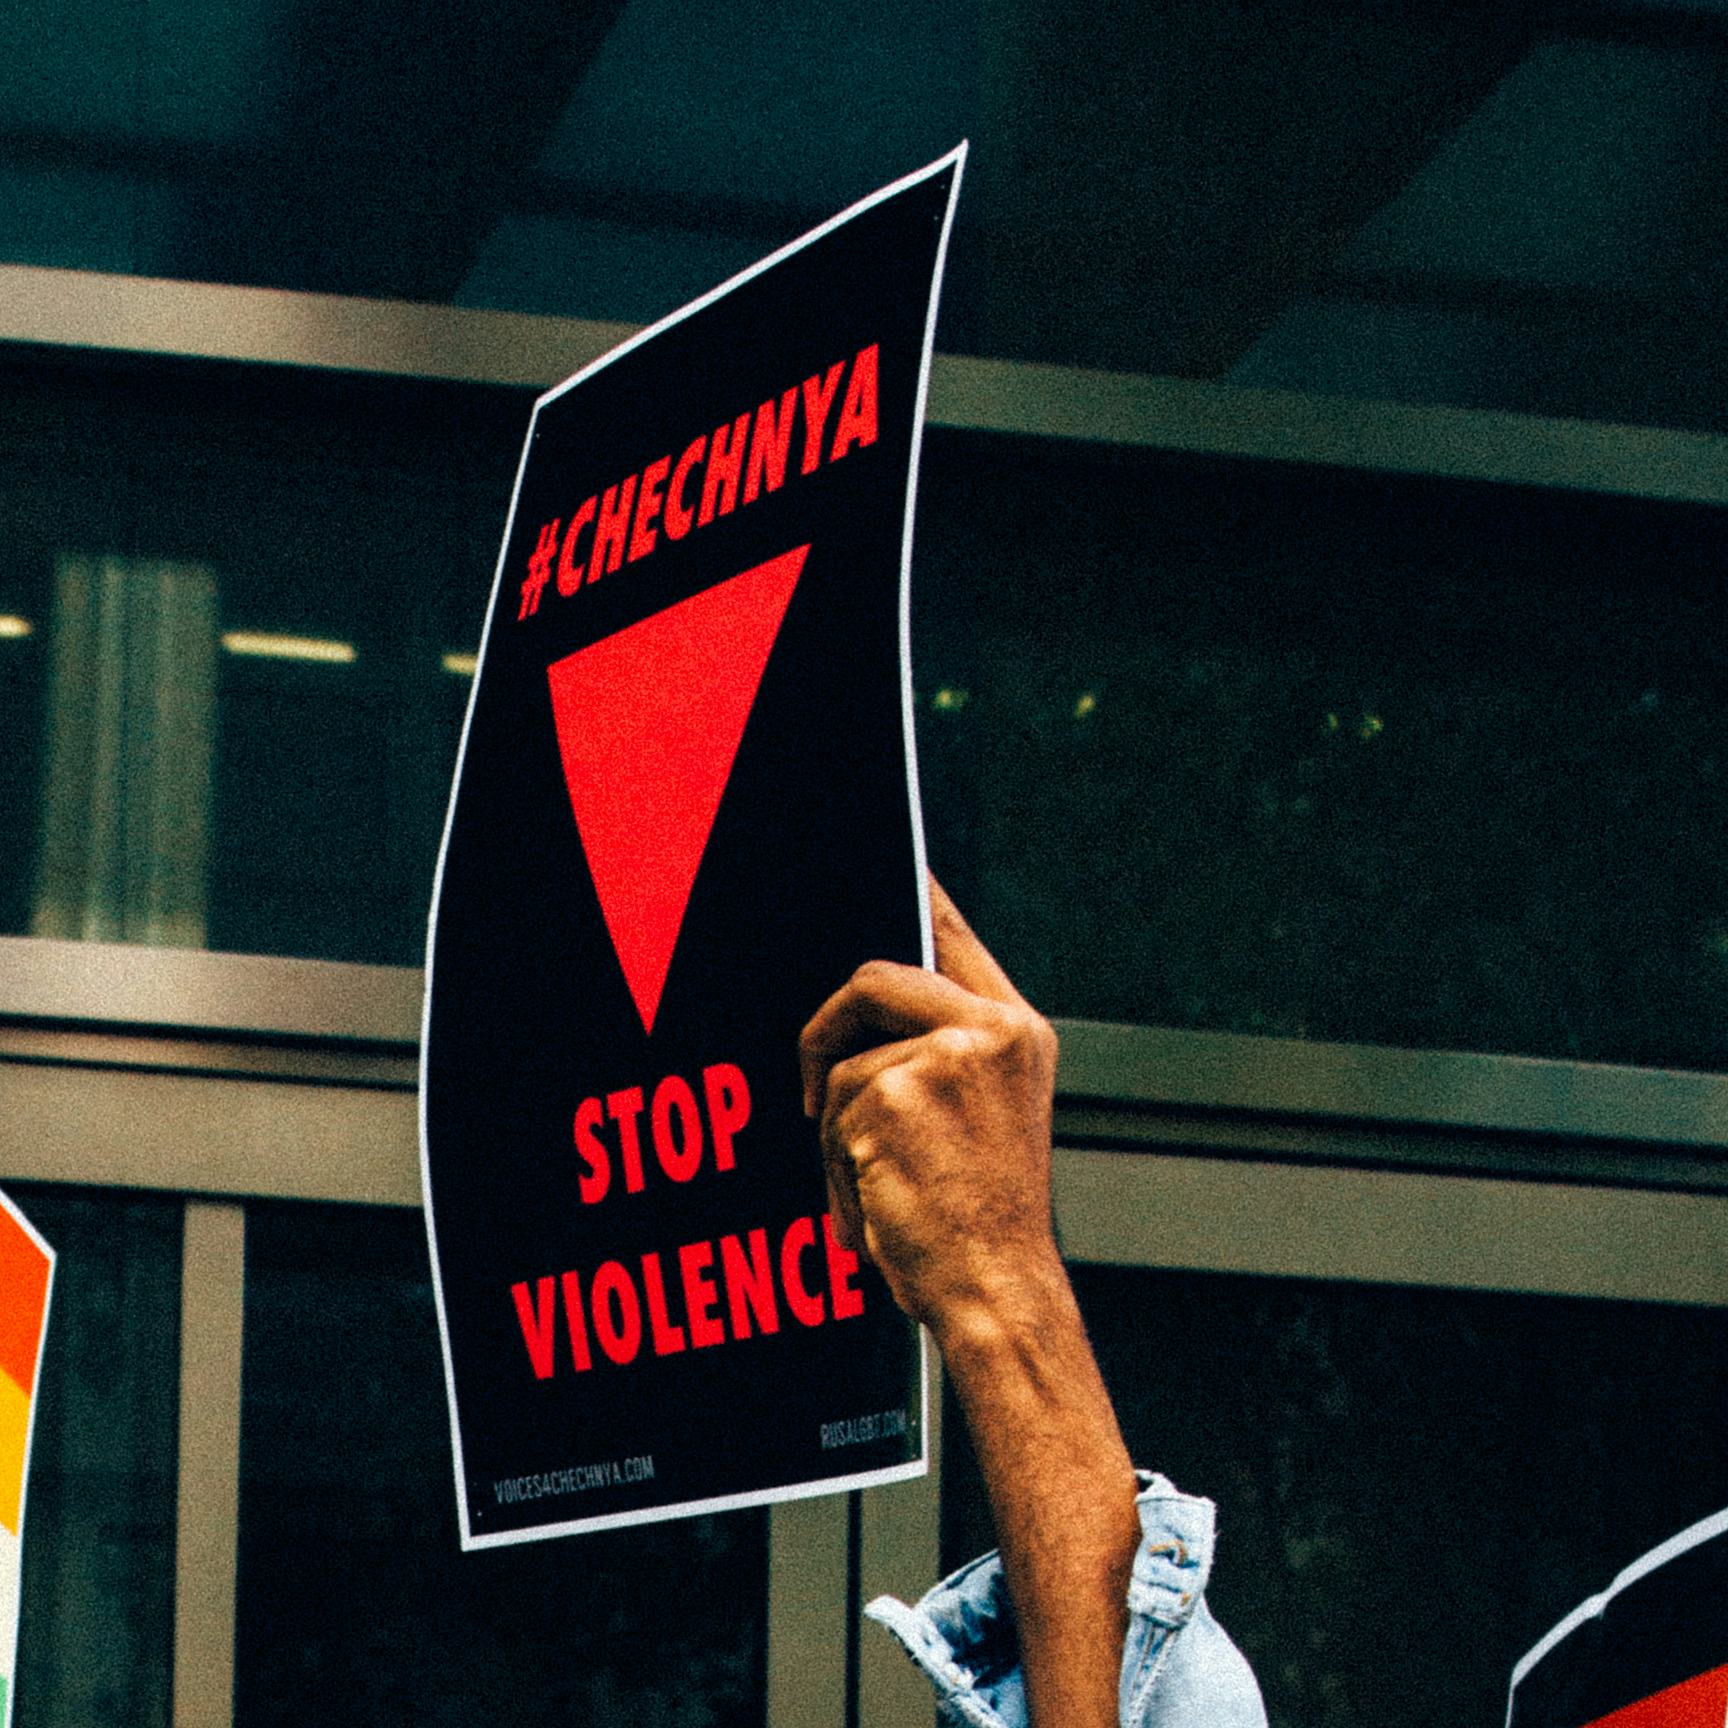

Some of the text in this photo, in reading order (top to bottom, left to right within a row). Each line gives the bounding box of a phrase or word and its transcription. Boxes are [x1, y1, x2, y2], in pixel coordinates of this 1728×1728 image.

[518, 343, 879, 620] #CHECHNYA
[573, 1062, 751, 1204] STOP
[511, 1212, 864, 1380] VIOLENCE
[494, 1454, 655, 1504] VOICES4CHECHNYA.COM
[820, 1409, 907, 1449] RUSALGBT.COM
